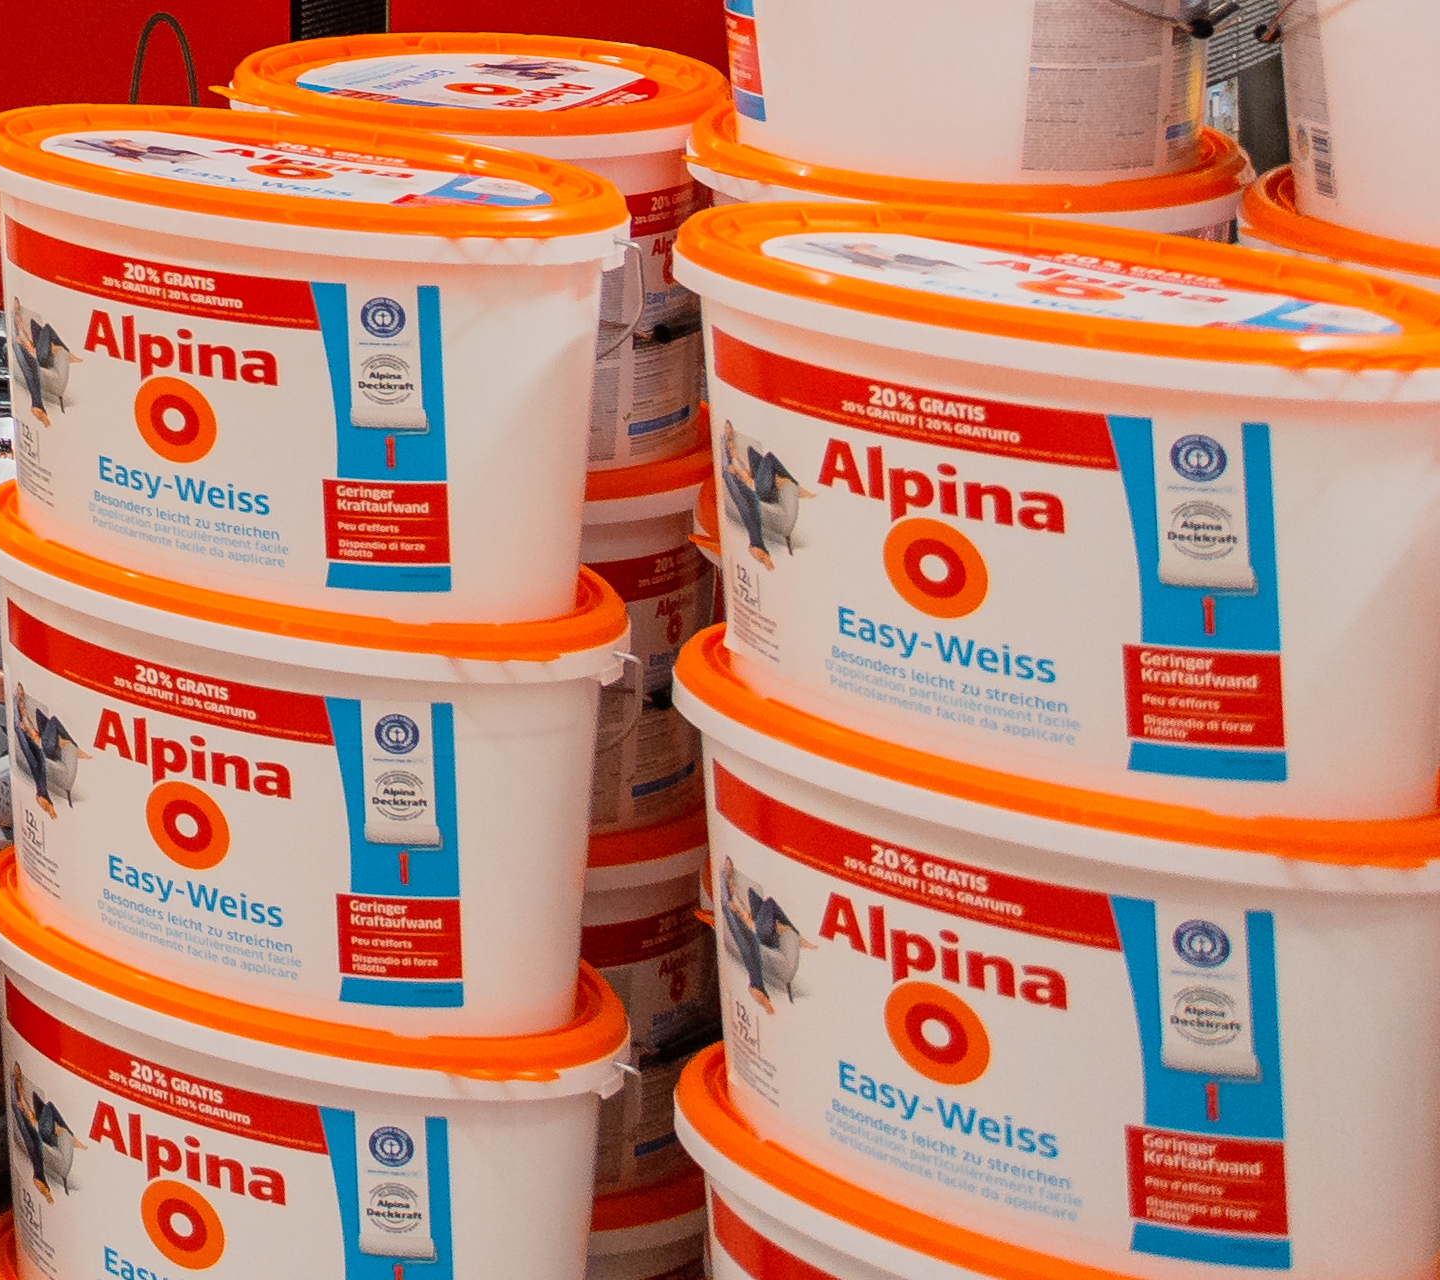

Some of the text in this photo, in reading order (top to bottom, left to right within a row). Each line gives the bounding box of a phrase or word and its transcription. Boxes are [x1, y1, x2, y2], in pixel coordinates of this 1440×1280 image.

[123, 262, 216, 292] 20% GRATIS
[83, 308, 280, 387] Alpina
[358, 381, 415, 392] Deckkraft
[369, 371, 402, 381] Alpina
[868, 385, 986, 423] 20% GRATIS
[98, 455, 271, 517] Easy-Weiss
[336, 485, 394, 501] Geringer
[818, 438, 1065, 534] Alpina
[93, 490, 281, 542] Besonders leicht zu streichen
[336, 498, 430, 515] Kraftaufwand
[837, 605, 1057, 685] Easy-Weiss
[1139, 651, 1213, 673] Geringer
[134, 663, 229, 701] 20% GRATIS
[1140, 669, 1259, 690] Kraftaufwand
[92, 707, 292, 800] Alpina
[107, 854, 284, 929] Easy-Weiss
[837, 1060, 1059, 1160] Easy-Weiss
